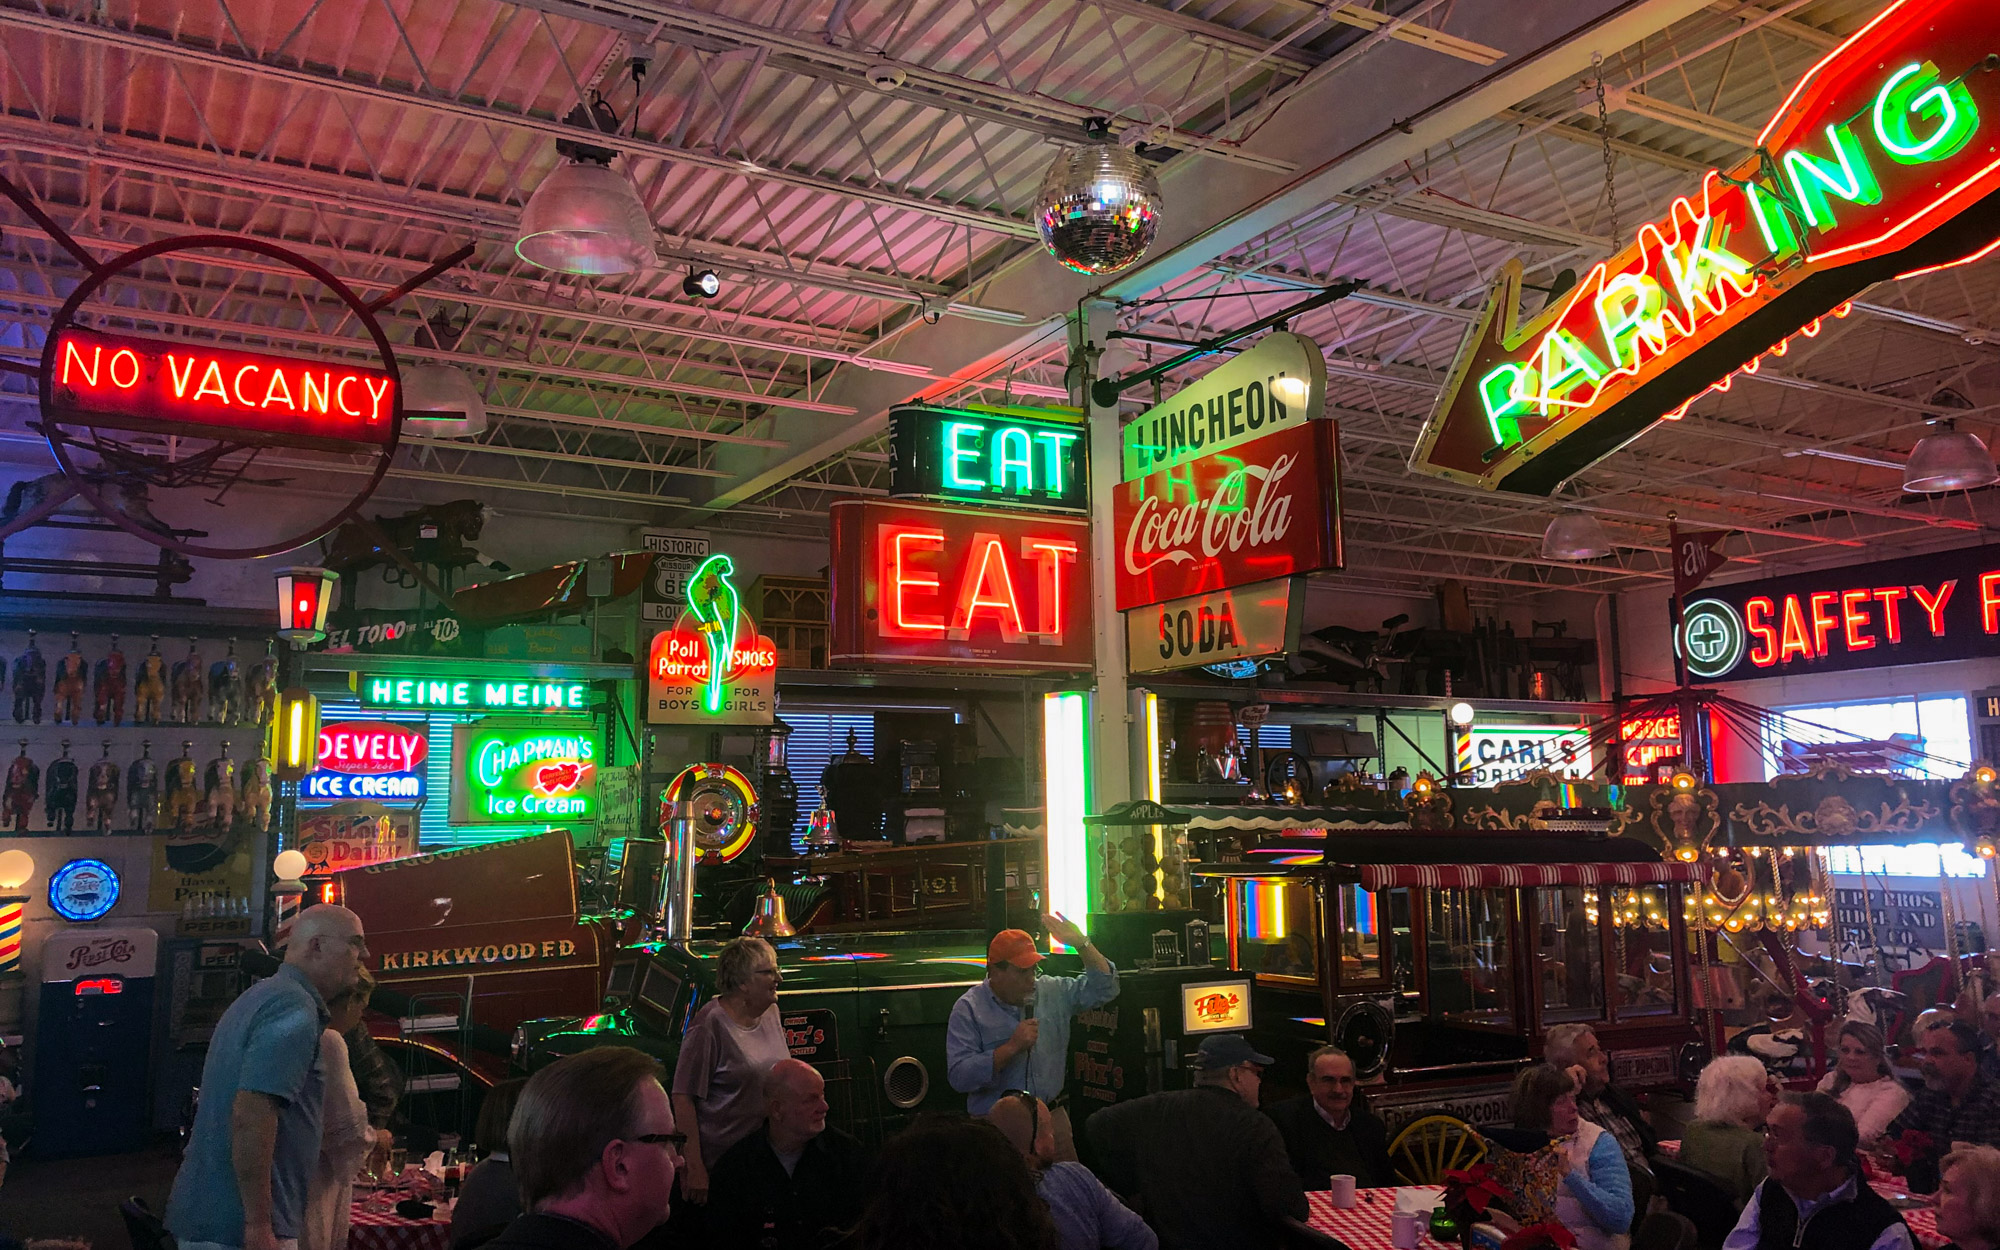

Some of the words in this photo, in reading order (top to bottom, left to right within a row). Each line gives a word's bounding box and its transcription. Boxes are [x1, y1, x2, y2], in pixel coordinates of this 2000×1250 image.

[1479, 60, 1979, 450] PARKING
[62, 341, 139, 388] NO
[168, 354, 389, 419] VACANCY
[1136, 371, 1287, 468] LUNCHEON
[942, 421, 1077, 499] EAT
[1124, 451, 1299, 575] Coca-Cola
[650, 538, 709, 555] HISTORIC
[661, 561, 694, 570] MISSOURI
[878, 523, 1078, 646] EAT
[1159, 602, 1238, 659] SODA
[1745, 579, 1958, 668] SAFETY
[328, 628, 350, 649] EL
[669, 640, 698, 658] Poll
[658, 658, 708, 676] Parrot
[734, 650, 774, 667] SHOES
[372, 680, 469, 706] HEINE
[485, 683, 583, 708] MEINE
[667, 686, 692, 695] FOR
[734, 688, 759, 697] FOR
[659, 700, 700, 710] BOYS
[724, 700, 766, 711] GIRLS
[479, 736, 592, 787] CHAPMAN'S
[1478, 738, 1575, 764] CARL'S
[309, 776, 343, 796] ICE
[349, 776, 419, 797] CREAM
[488, 794, 516, 814] Ice
[522, 794, 585, 814] Cream
[1130, 804, 1165, 819] APPLES
[181, 878, 213, 886] Have
[174, 887, 231, 904] Pepsi
[184, 921, 245, 931] PEPSI
[382, 943, 535, 971] KIRKWOOD
[542, 939, 576, 957] F.D.
